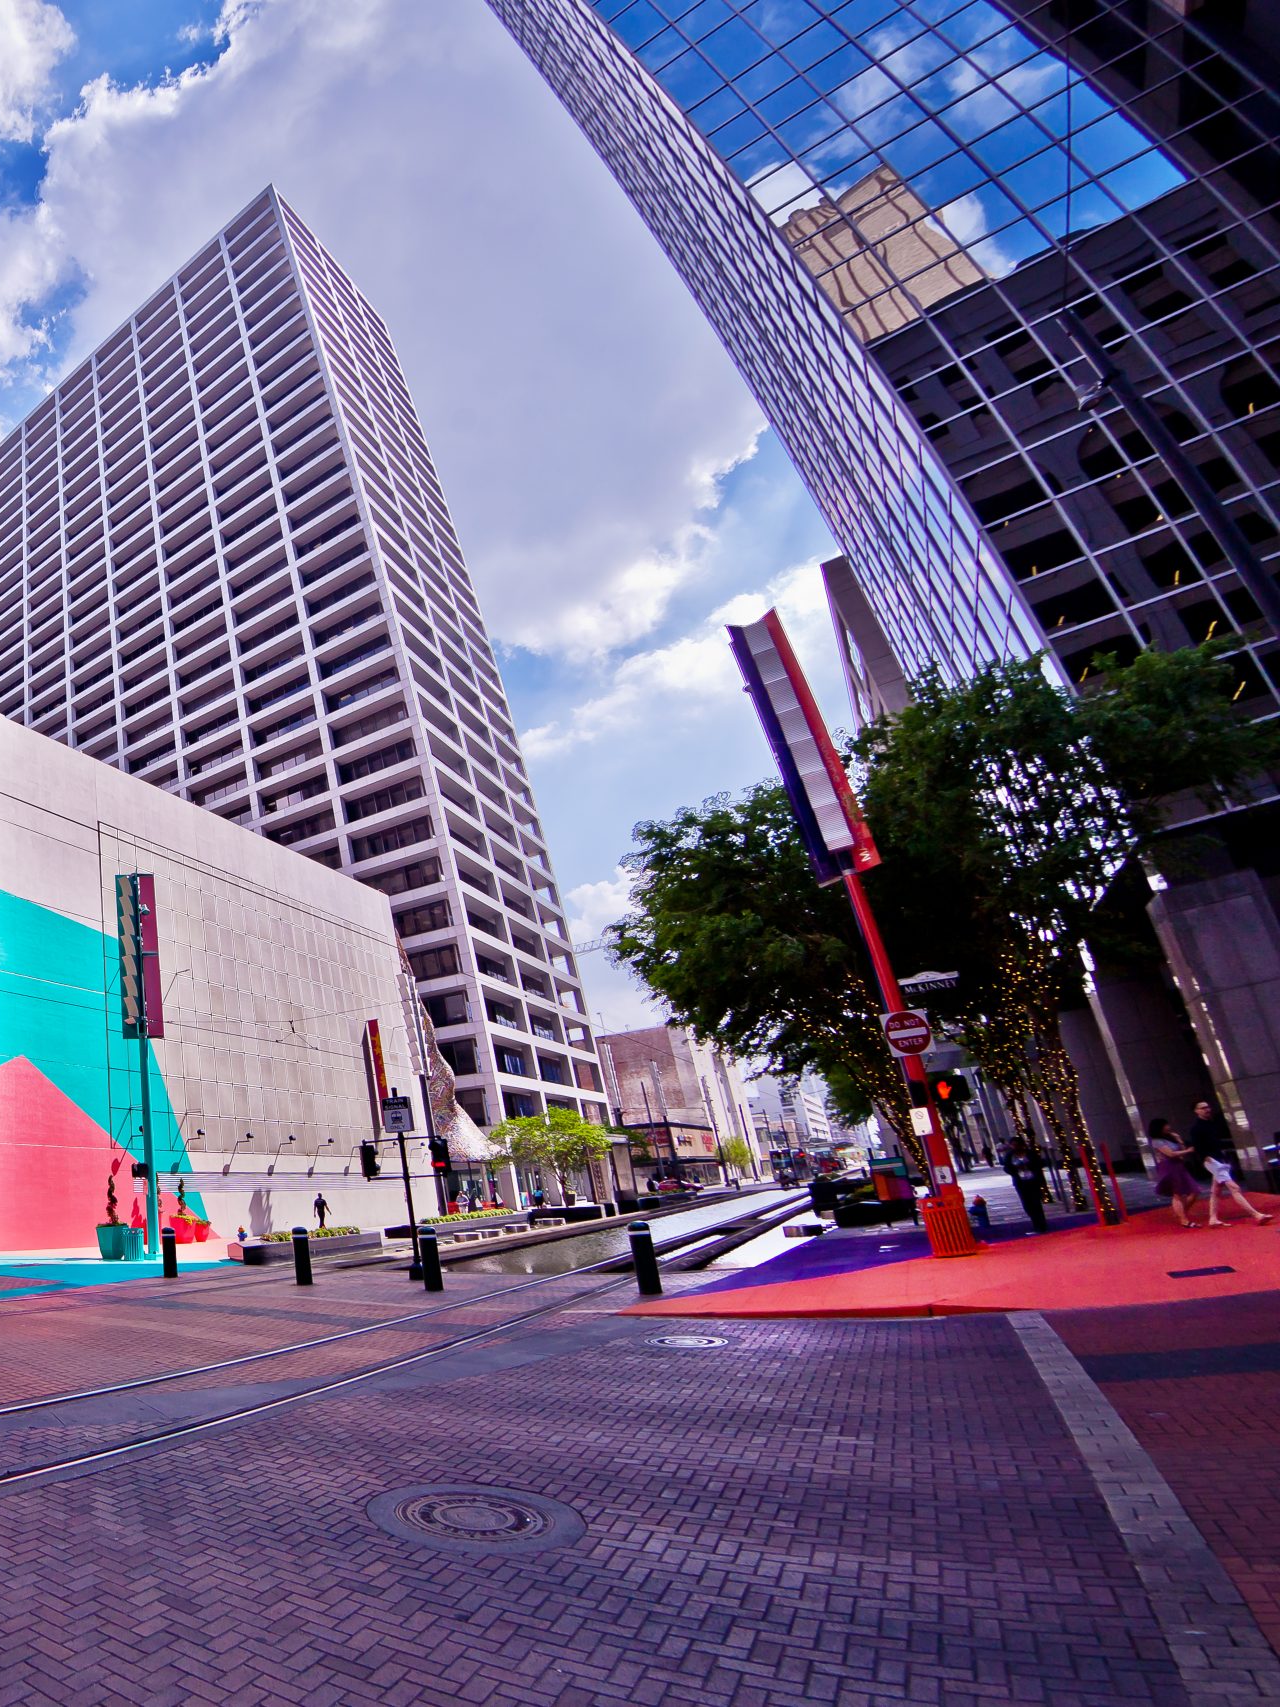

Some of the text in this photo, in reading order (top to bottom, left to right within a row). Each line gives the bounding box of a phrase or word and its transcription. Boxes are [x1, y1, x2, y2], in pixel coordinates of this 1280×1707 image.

[904, 979, 957, 993] McKINNEY
[889, 1018, 920, 1029] DO NOT
[898, 1038, 924, 1047] ENTER
